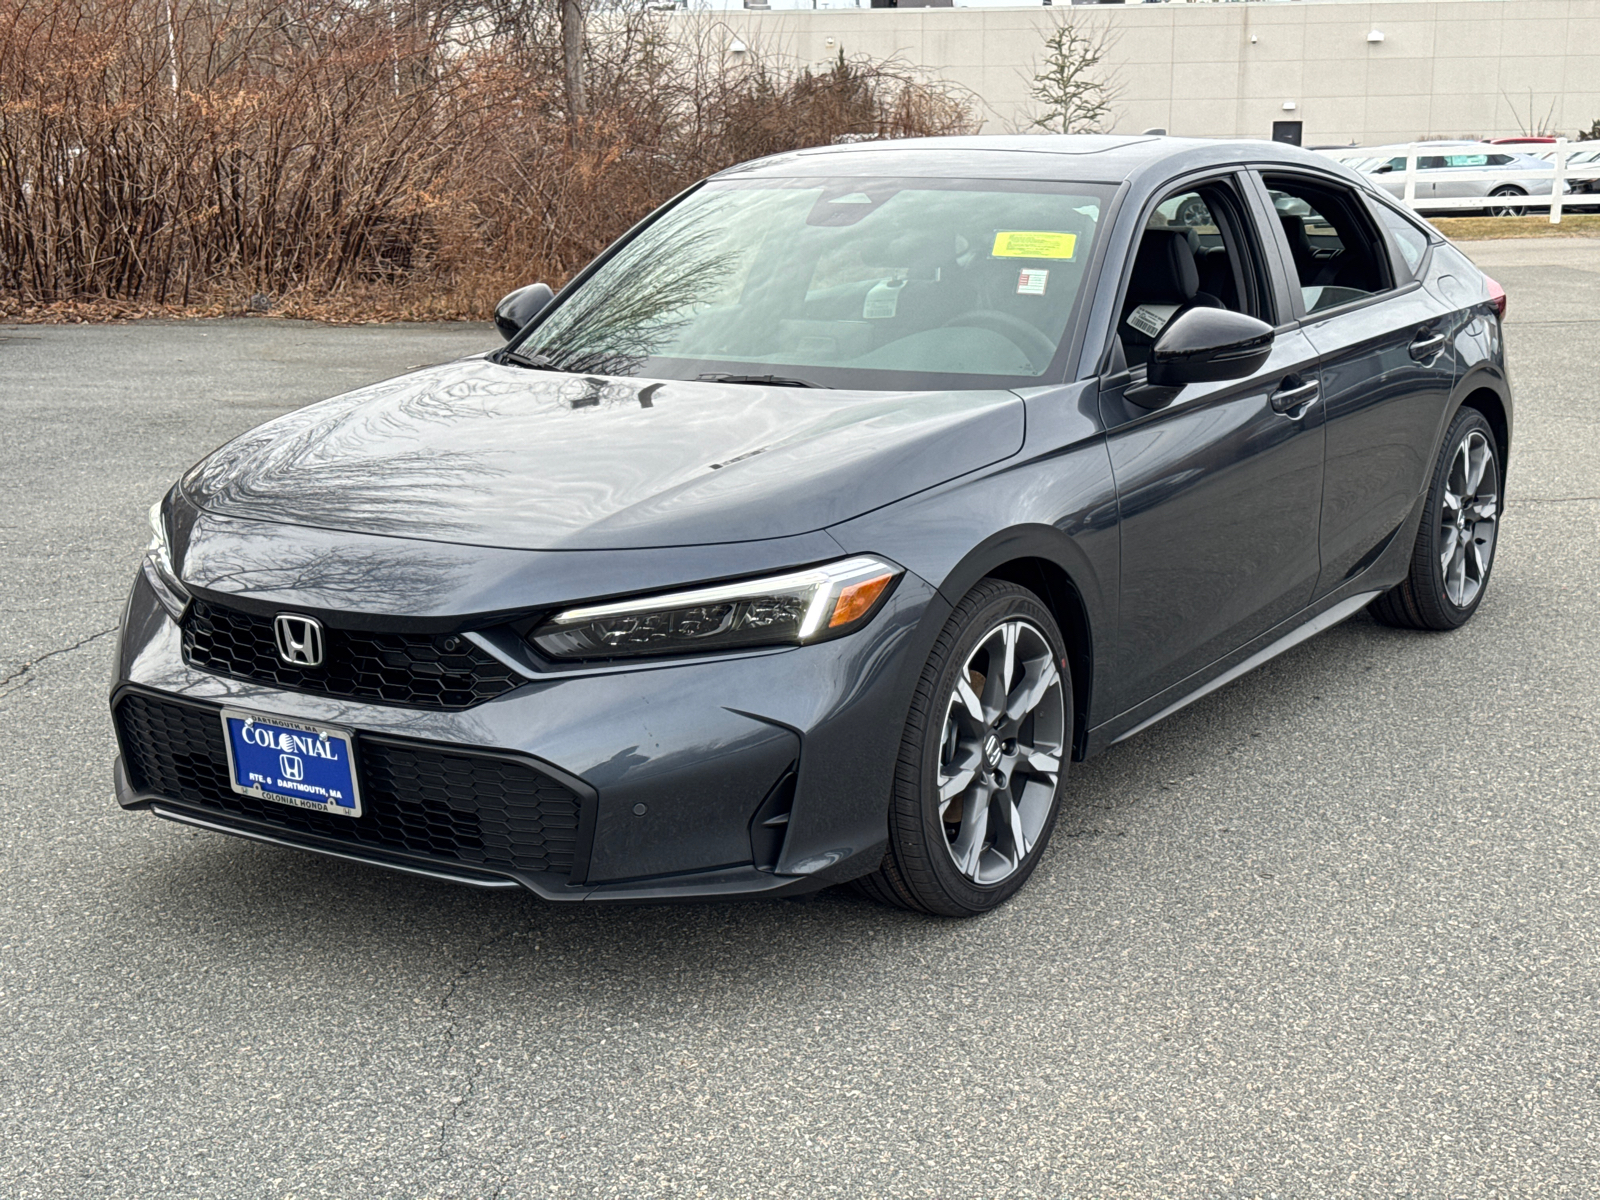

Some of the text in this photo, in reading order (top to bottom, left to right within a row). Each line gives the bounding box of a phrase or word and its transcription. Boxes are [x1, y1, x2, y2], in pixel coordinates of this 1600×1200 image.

[241, 725, 338, 760] COLONIAL
[249, 772, 266, 783] RTE.
[277, 779, 329, 797] DARTMOUTH,
[329, 789, 343, 799] MA
[261, 792, 329, 812] COLONIAL HONDA
